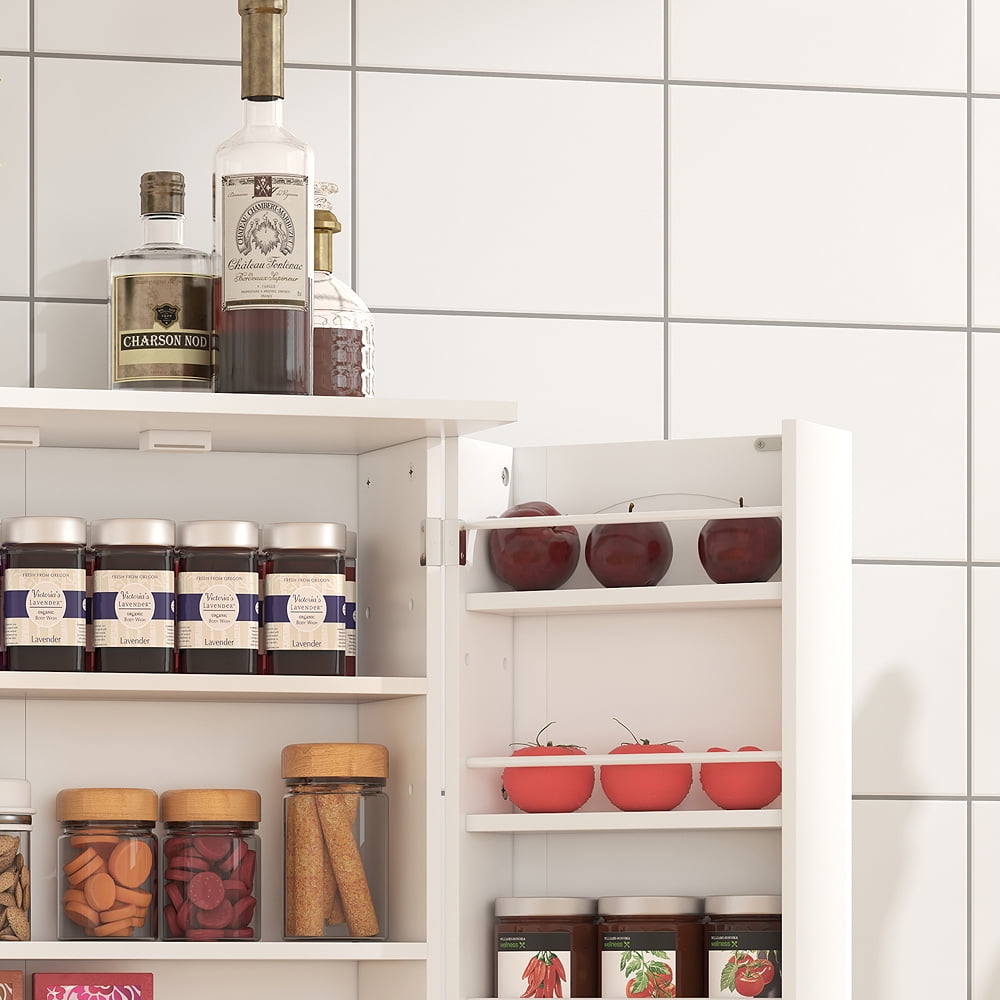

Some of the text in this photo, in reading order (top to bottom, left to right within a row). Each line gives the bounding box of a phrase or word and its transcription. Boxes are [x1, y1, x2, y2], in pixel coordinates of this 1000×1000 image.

[124, 335, 207, 347] CHARSON NOD
[205, 638, 234, 646] Lavender
